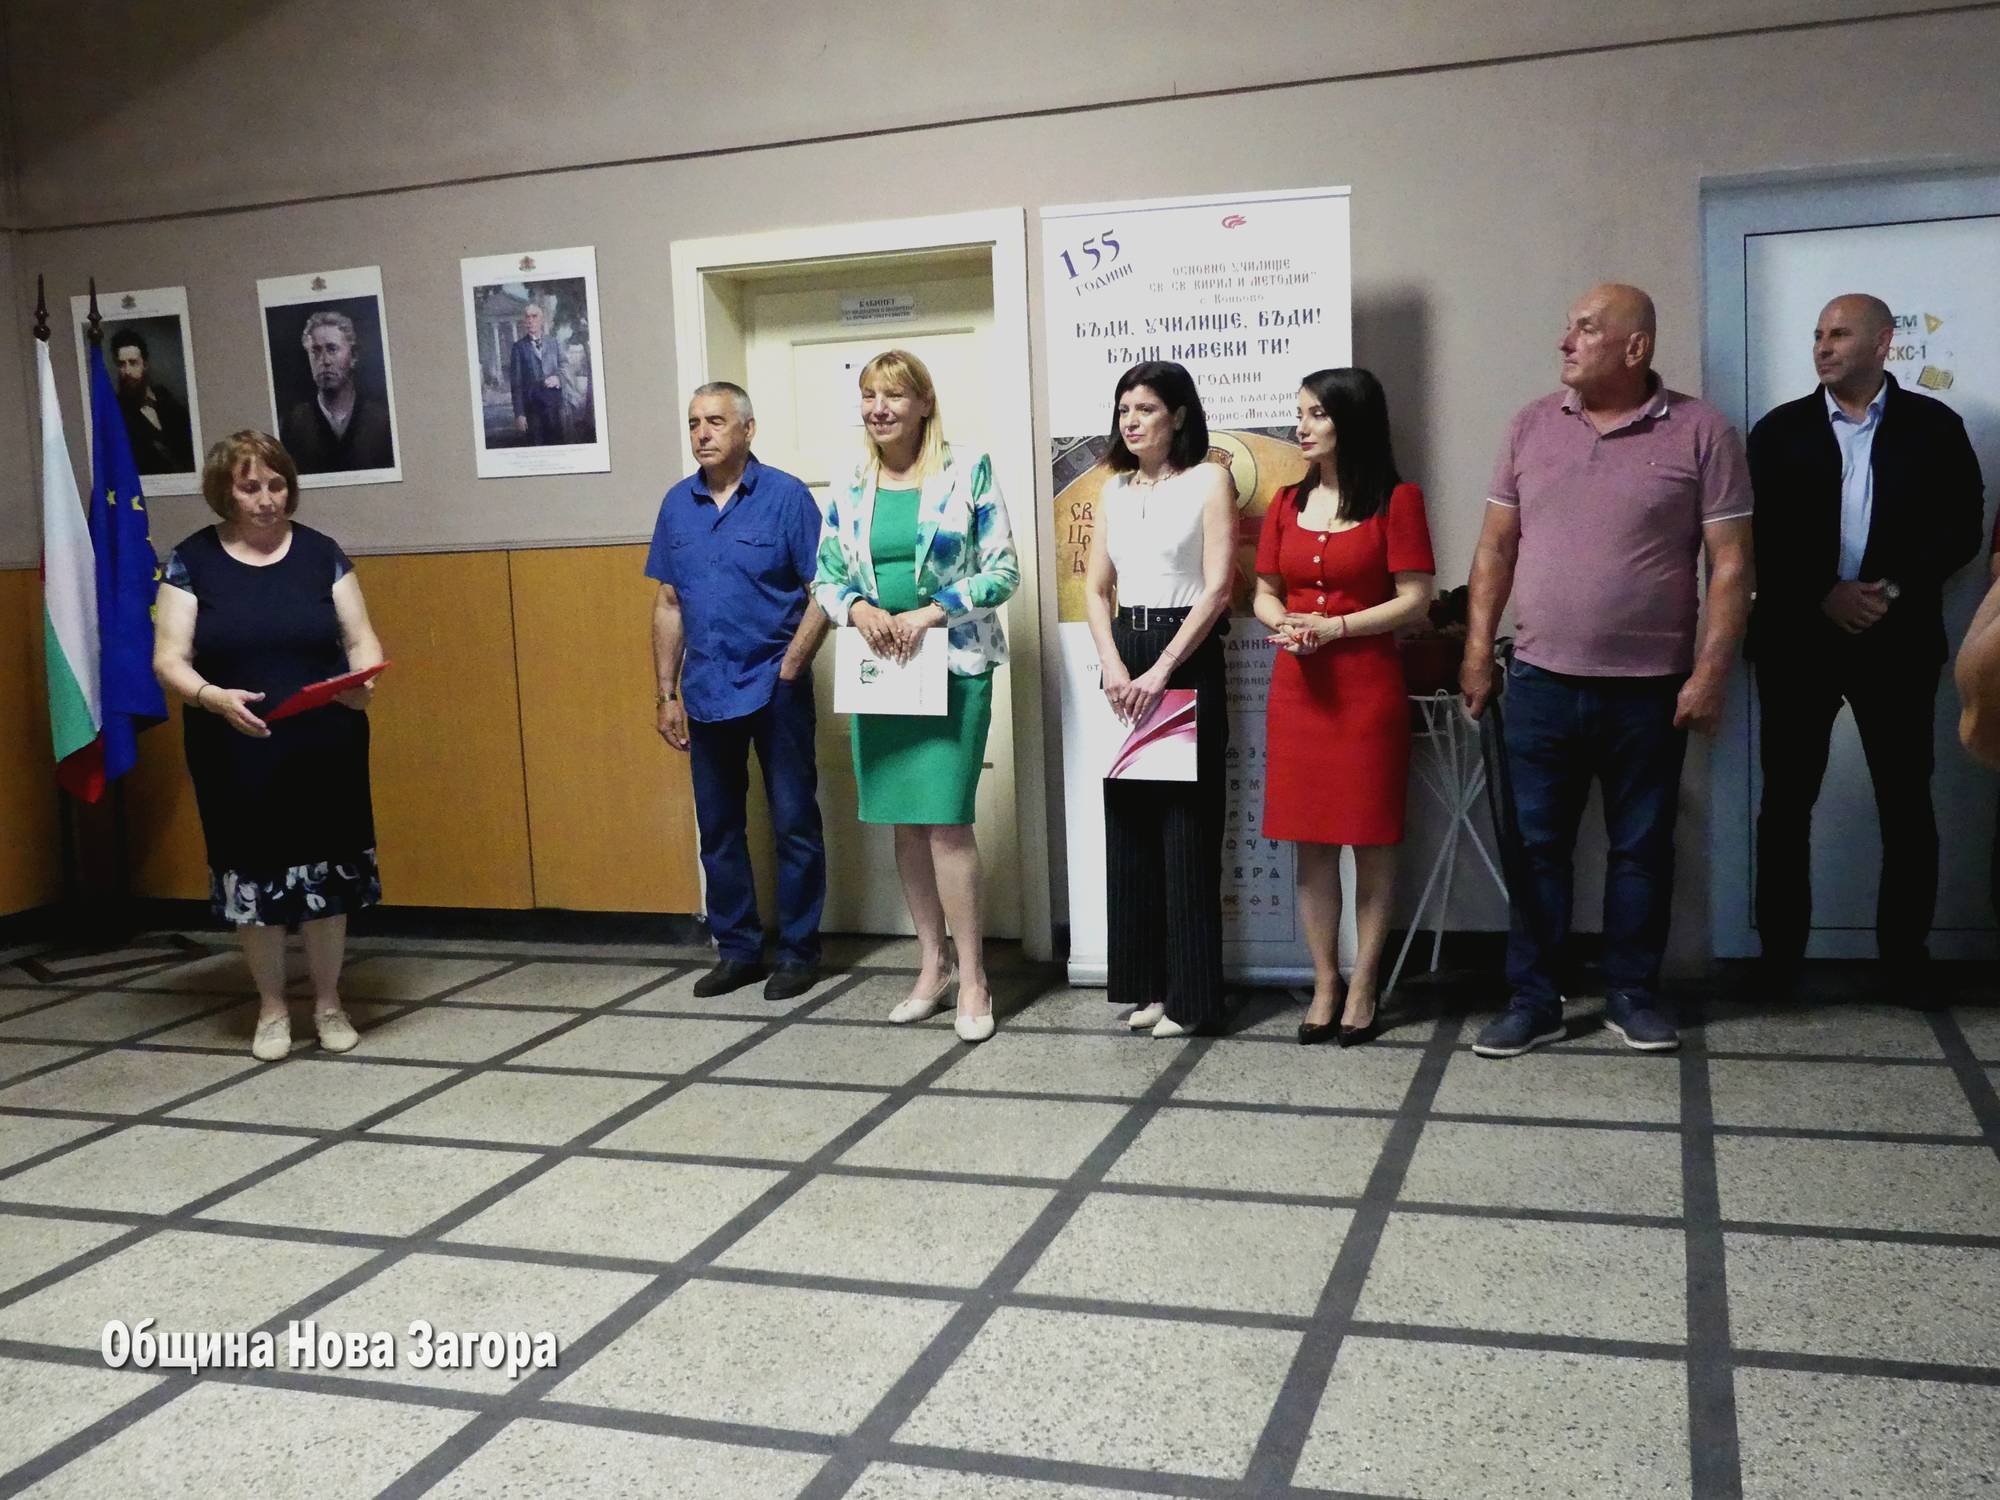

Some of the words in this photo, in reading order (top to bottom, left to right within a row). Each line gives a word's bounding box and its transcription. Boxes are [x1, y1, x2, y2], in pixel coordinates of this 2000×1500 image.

[1060, 229, 1120, 280] 155
[1231, 258, 1291, 273] УЧИЛИЩЕ
[1075, 263, 1133, 297] ГОДИНИ
[1194, 278, 1232, 290] КИРИЛ
[1238, 277, 1245, 288] И
[1258, 308, 1321, 328] БЪДИ!
[1107, 345, 1160, 364] БЪДИ
[1171, 340, 1247, 360] НАВЕКИ
[1257, 338, 1290, 354] ТИ!
